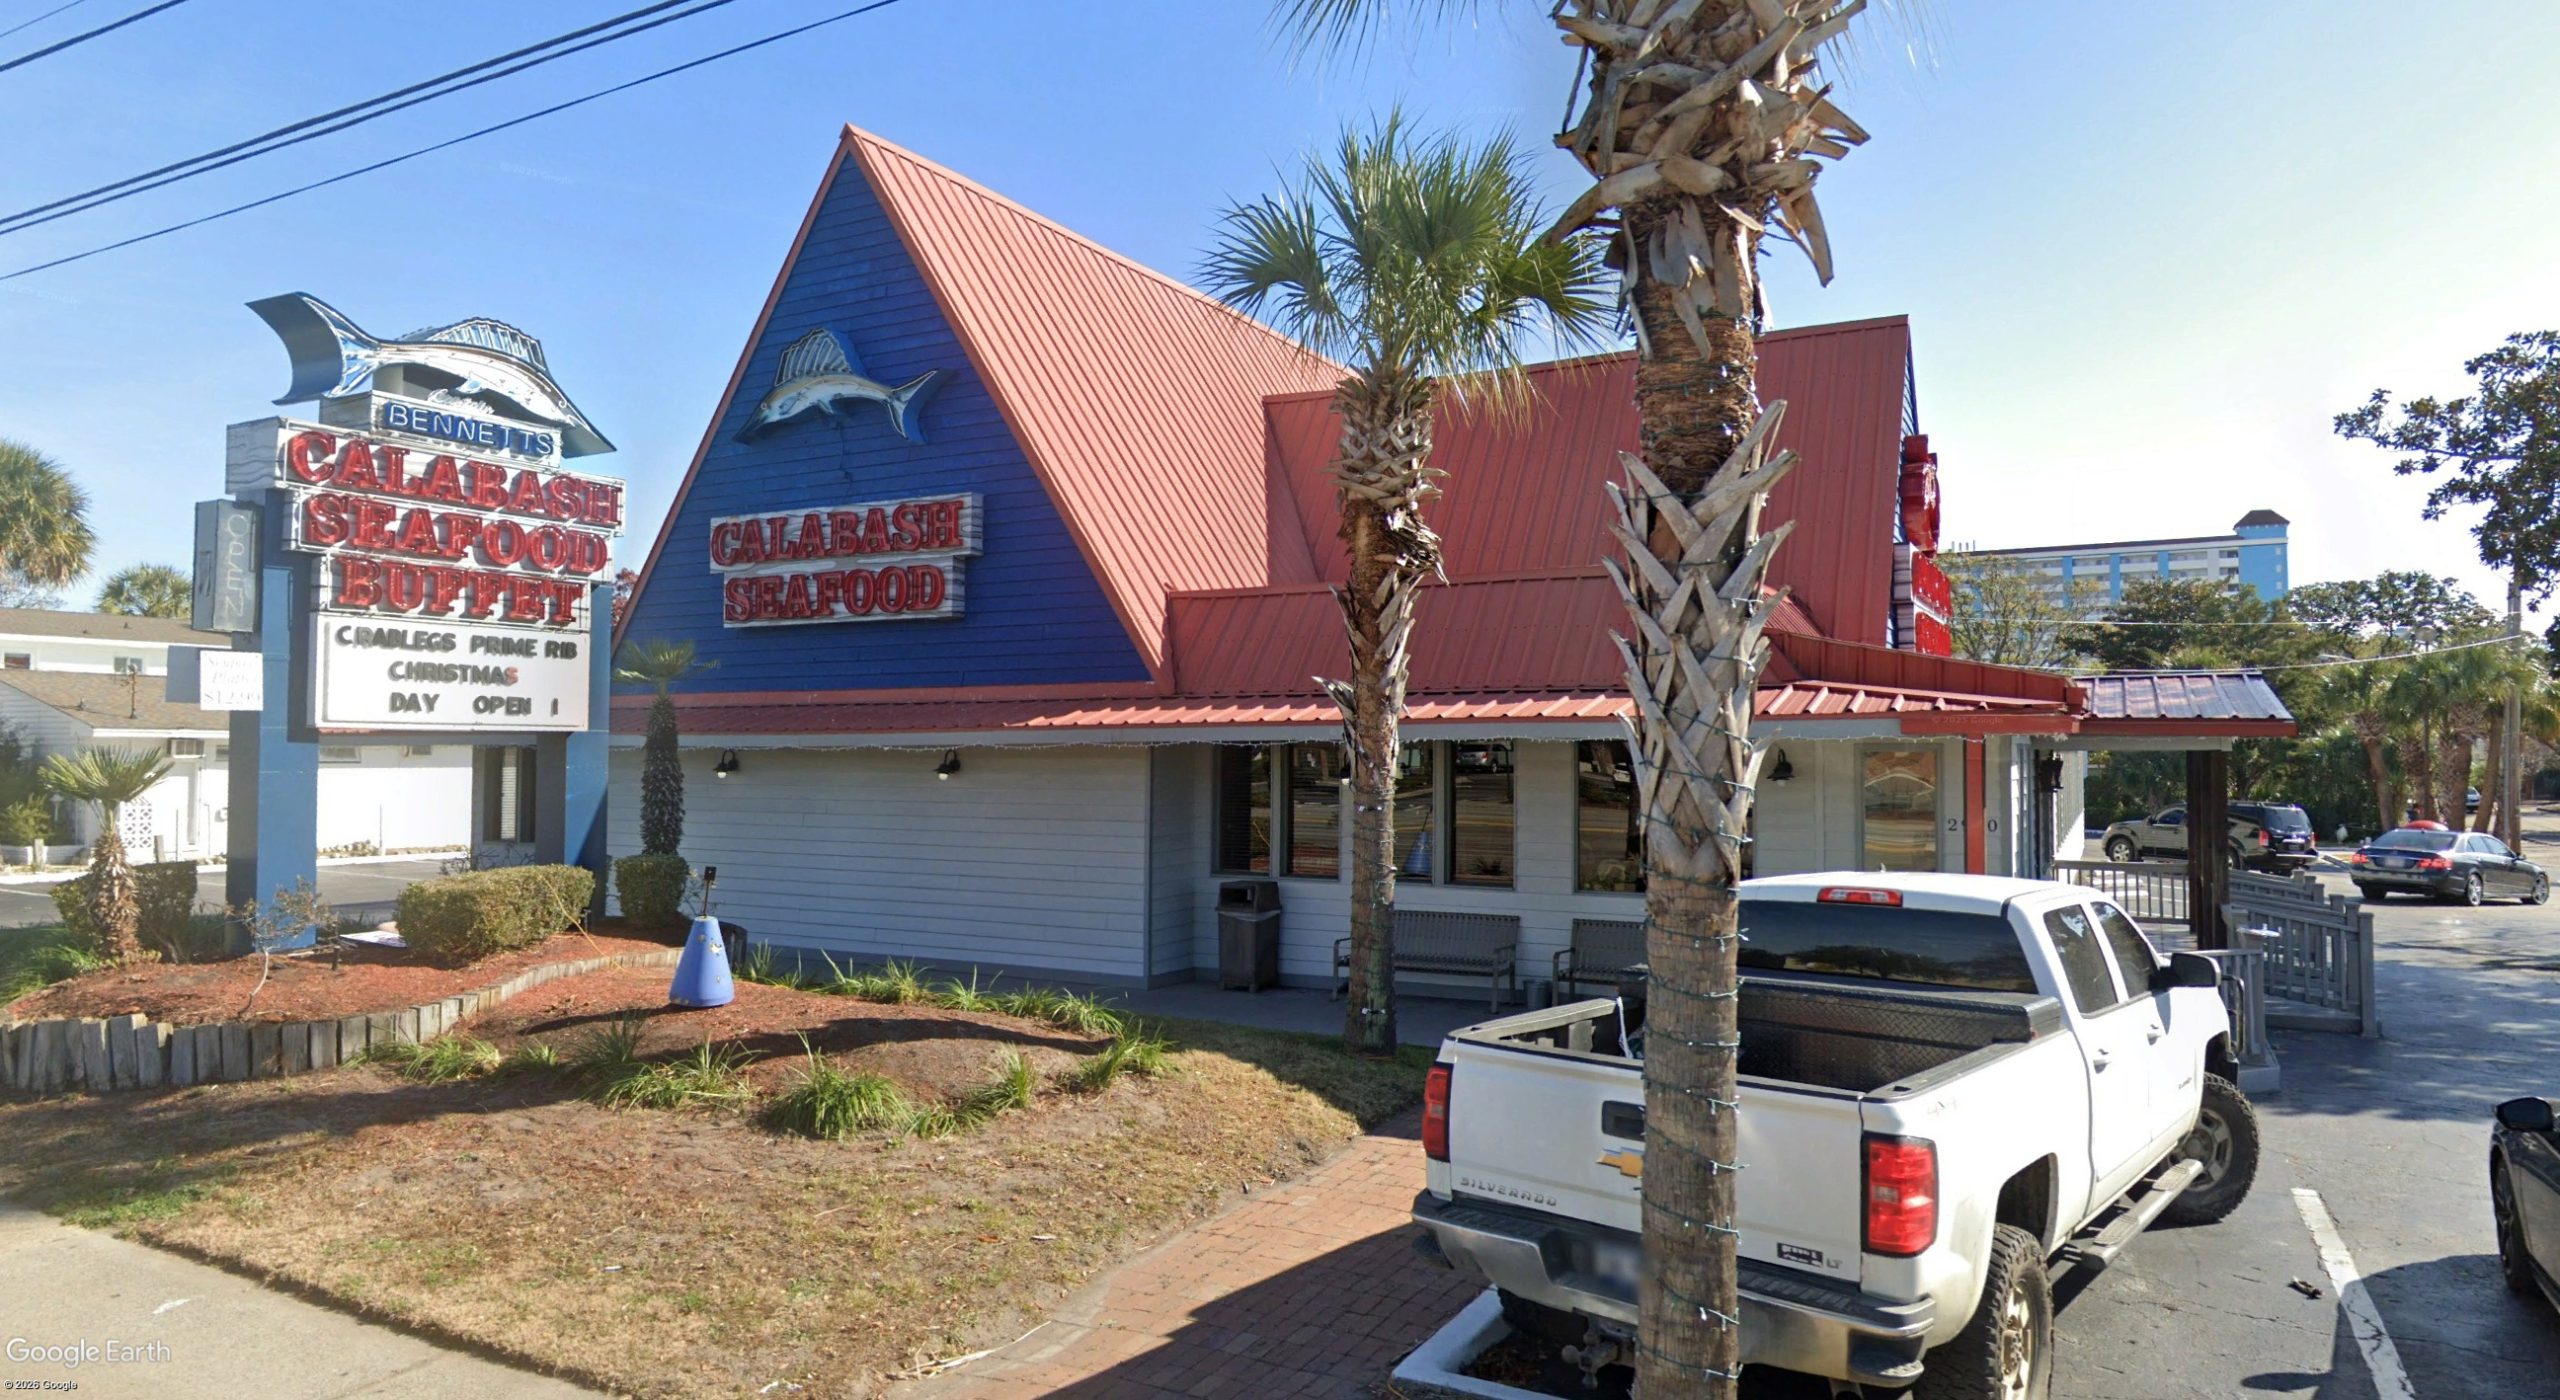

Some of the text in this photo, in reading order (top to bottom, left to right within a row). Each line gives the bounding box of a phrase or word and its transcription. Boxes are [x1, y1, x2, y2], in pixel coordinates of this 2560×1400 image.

[389, 403, 552, 454] BENNETTS
[287, 430, 622, 526] CALABASH
[303, 493, 608, 574] SEAFOOD
[711, 500, 964, 566] CALABASH
[337, 556, 584, 622] BUFFET
[724, 565, 945, 621] SEAFOOD
[335, 625, 578, 660] CRABLEGS PRIME RIB
[387, 660, 519, 686] CHRISTMAS
[388, 692, 440, 714] DAY
[472, 695, 532, 716] OPEN
[1947, 817, 1998, 832] 20
[1460, 1177, 1557, 1206] SILVERADO
